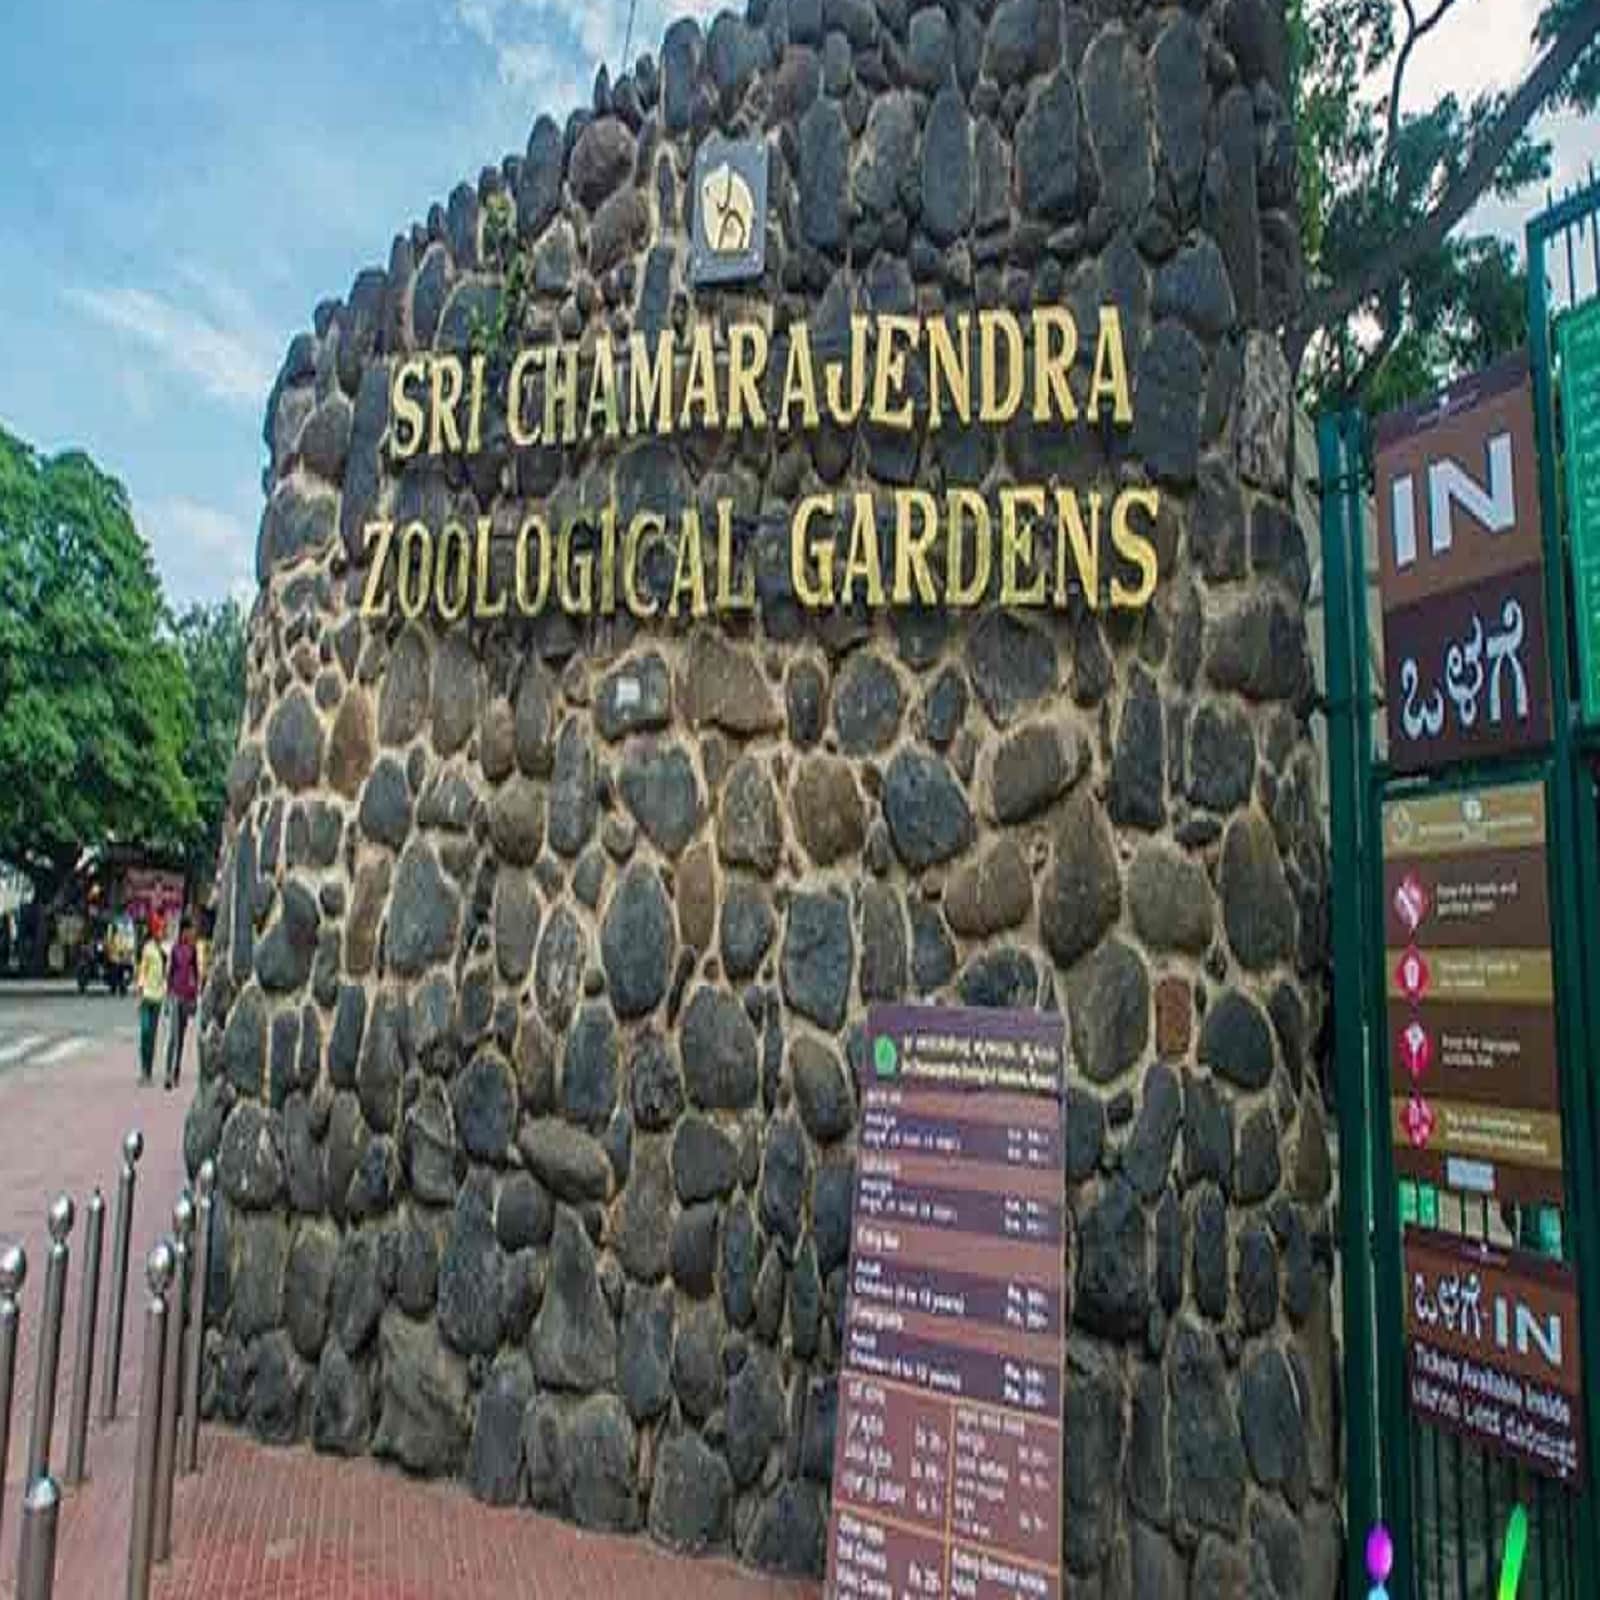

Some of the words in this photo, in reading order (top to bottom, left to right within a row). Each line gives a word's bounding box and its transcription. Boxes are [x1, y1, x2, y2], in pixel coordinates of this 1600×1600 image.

[389, 352, 486, 459] SRI
[506, 304, 1134, 447] CHAMARAJENDRA
[359, 498, 756, 620] ZOOLOGICAL
[789, 484, 1163, 610] GARDENS
[1391, 431, 1516, 569] IN
[1493, 1294, 1562, 1367] IN
